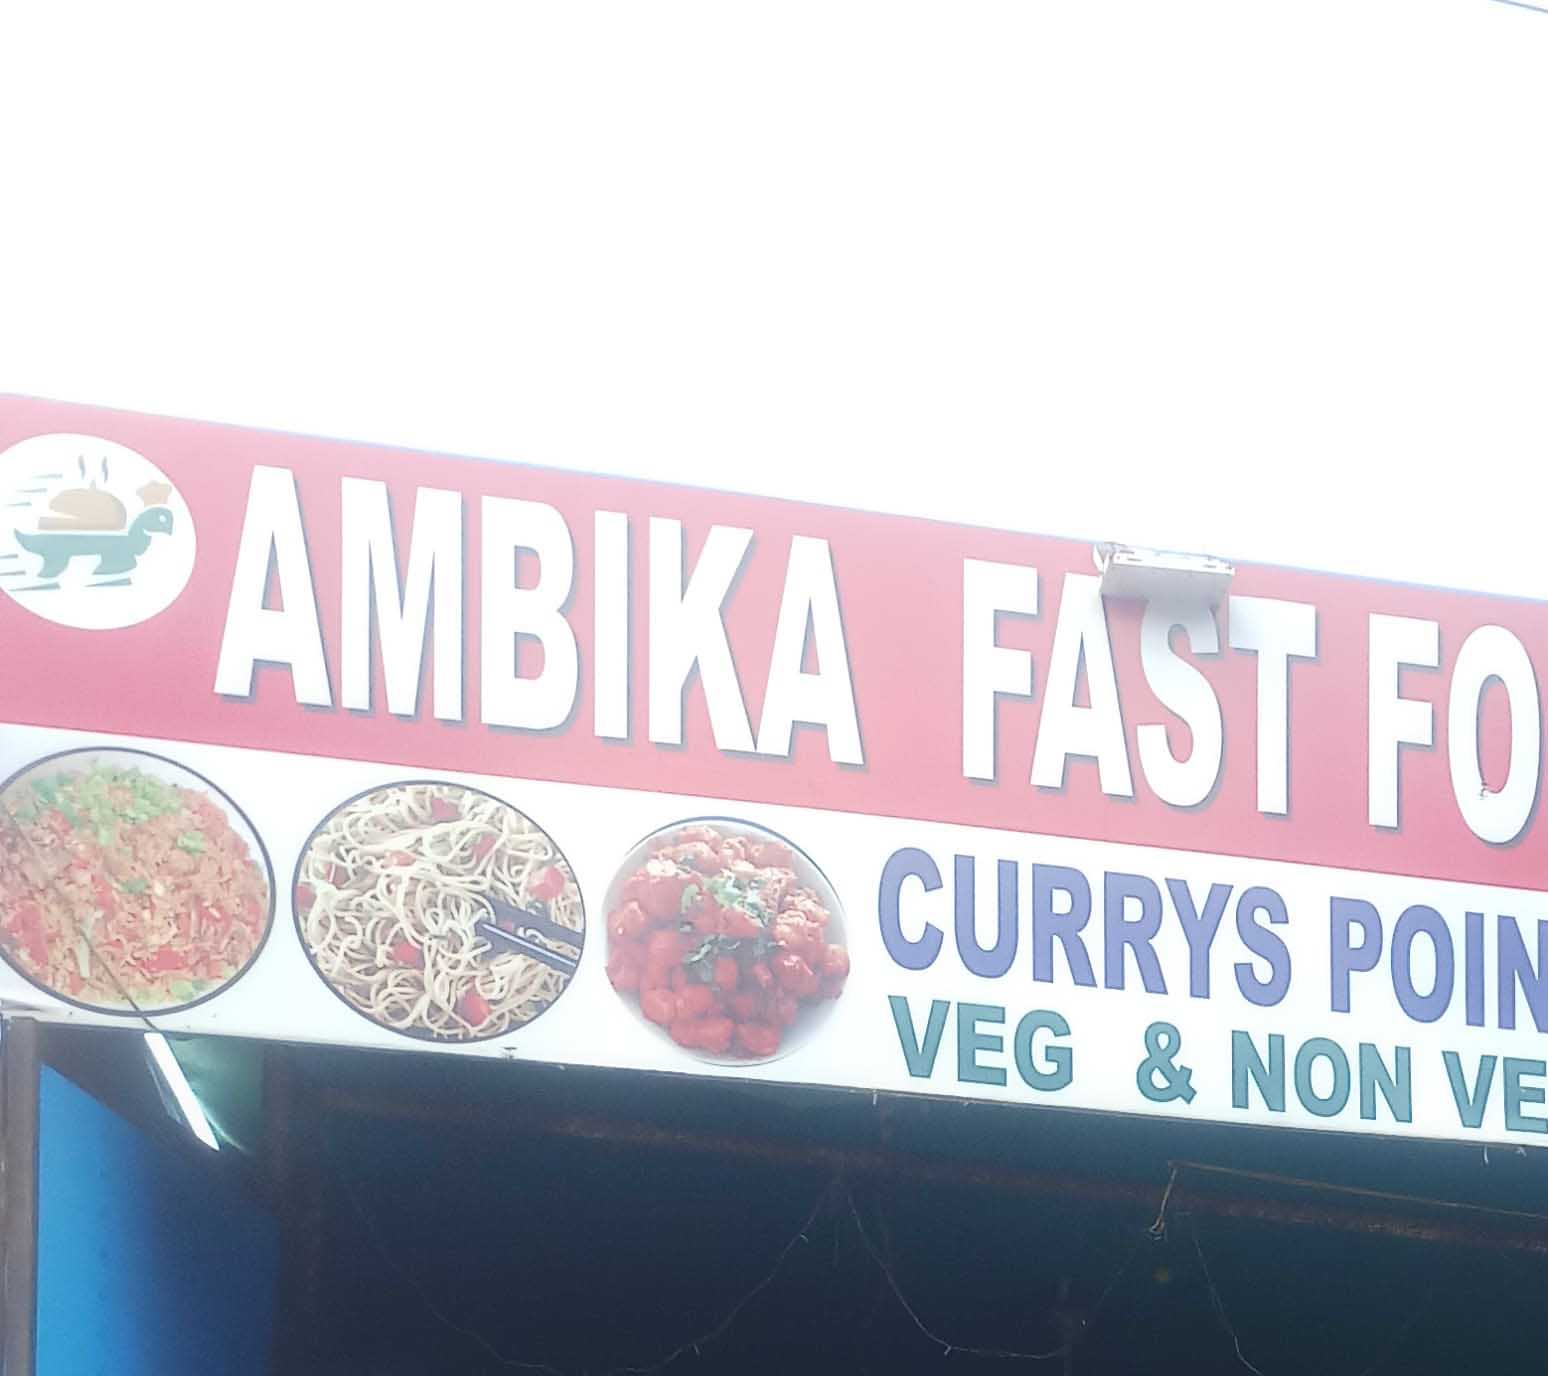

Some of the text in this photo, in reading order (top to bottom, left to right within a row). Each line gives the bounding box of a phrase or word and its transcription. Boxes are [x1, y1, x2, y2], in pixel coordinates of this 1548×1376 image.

[214, 464, 866, 766] AMBIKA
[963, 556, 1317, 815] FAST
[877, 846, 1292, 1008] CURRYS
[887, 995, 1075, 1092] VEG
[1136, 1022, 1197, 1104] &
[1231, 1031, 1412, 1124] NON
